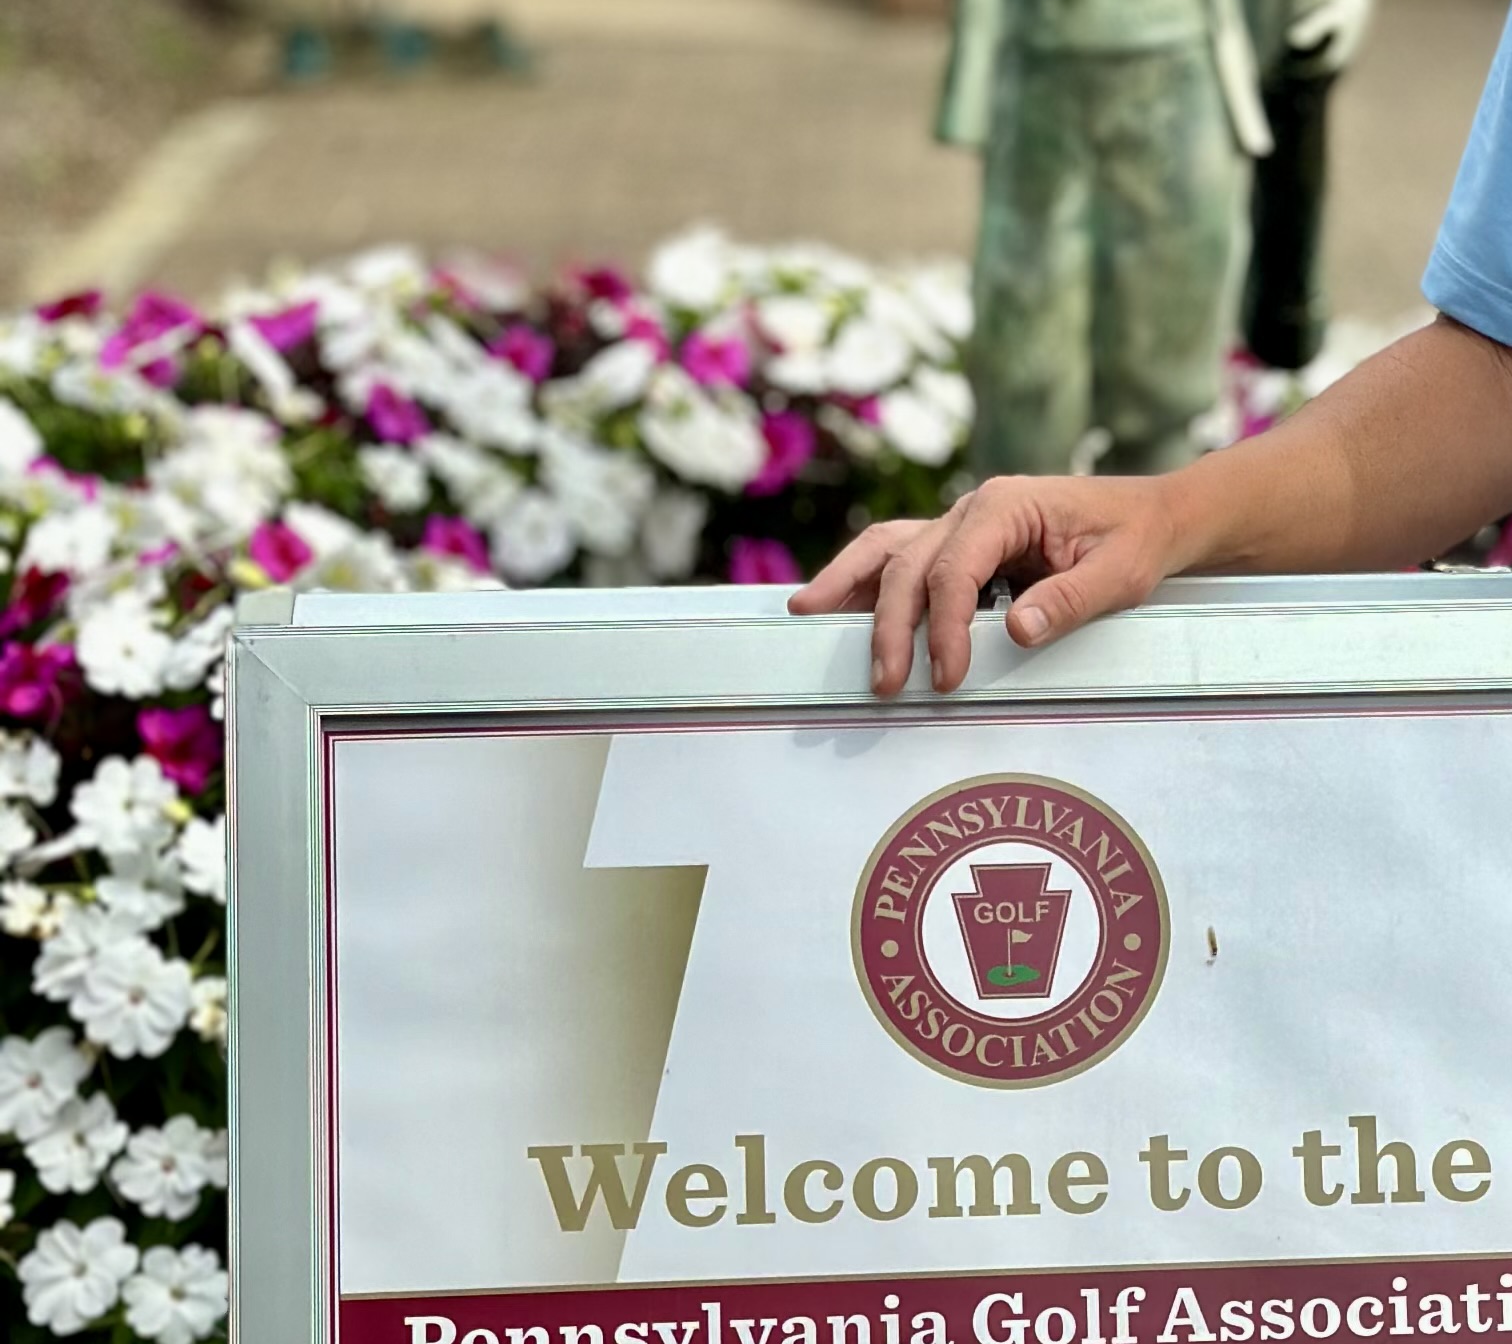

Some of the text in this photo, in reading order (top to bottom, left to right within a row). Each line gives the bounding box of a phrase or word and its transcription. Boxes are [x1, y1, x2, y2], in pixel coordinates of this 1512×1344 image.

[873, 795, 1144, 924] PENNSYLVANIA
[974, 901, 1049, 924] GOLF
[880, 957, 1143, 1068] ASSOCIATION
[527, 1115, 1492, 1233] Welcome to the
